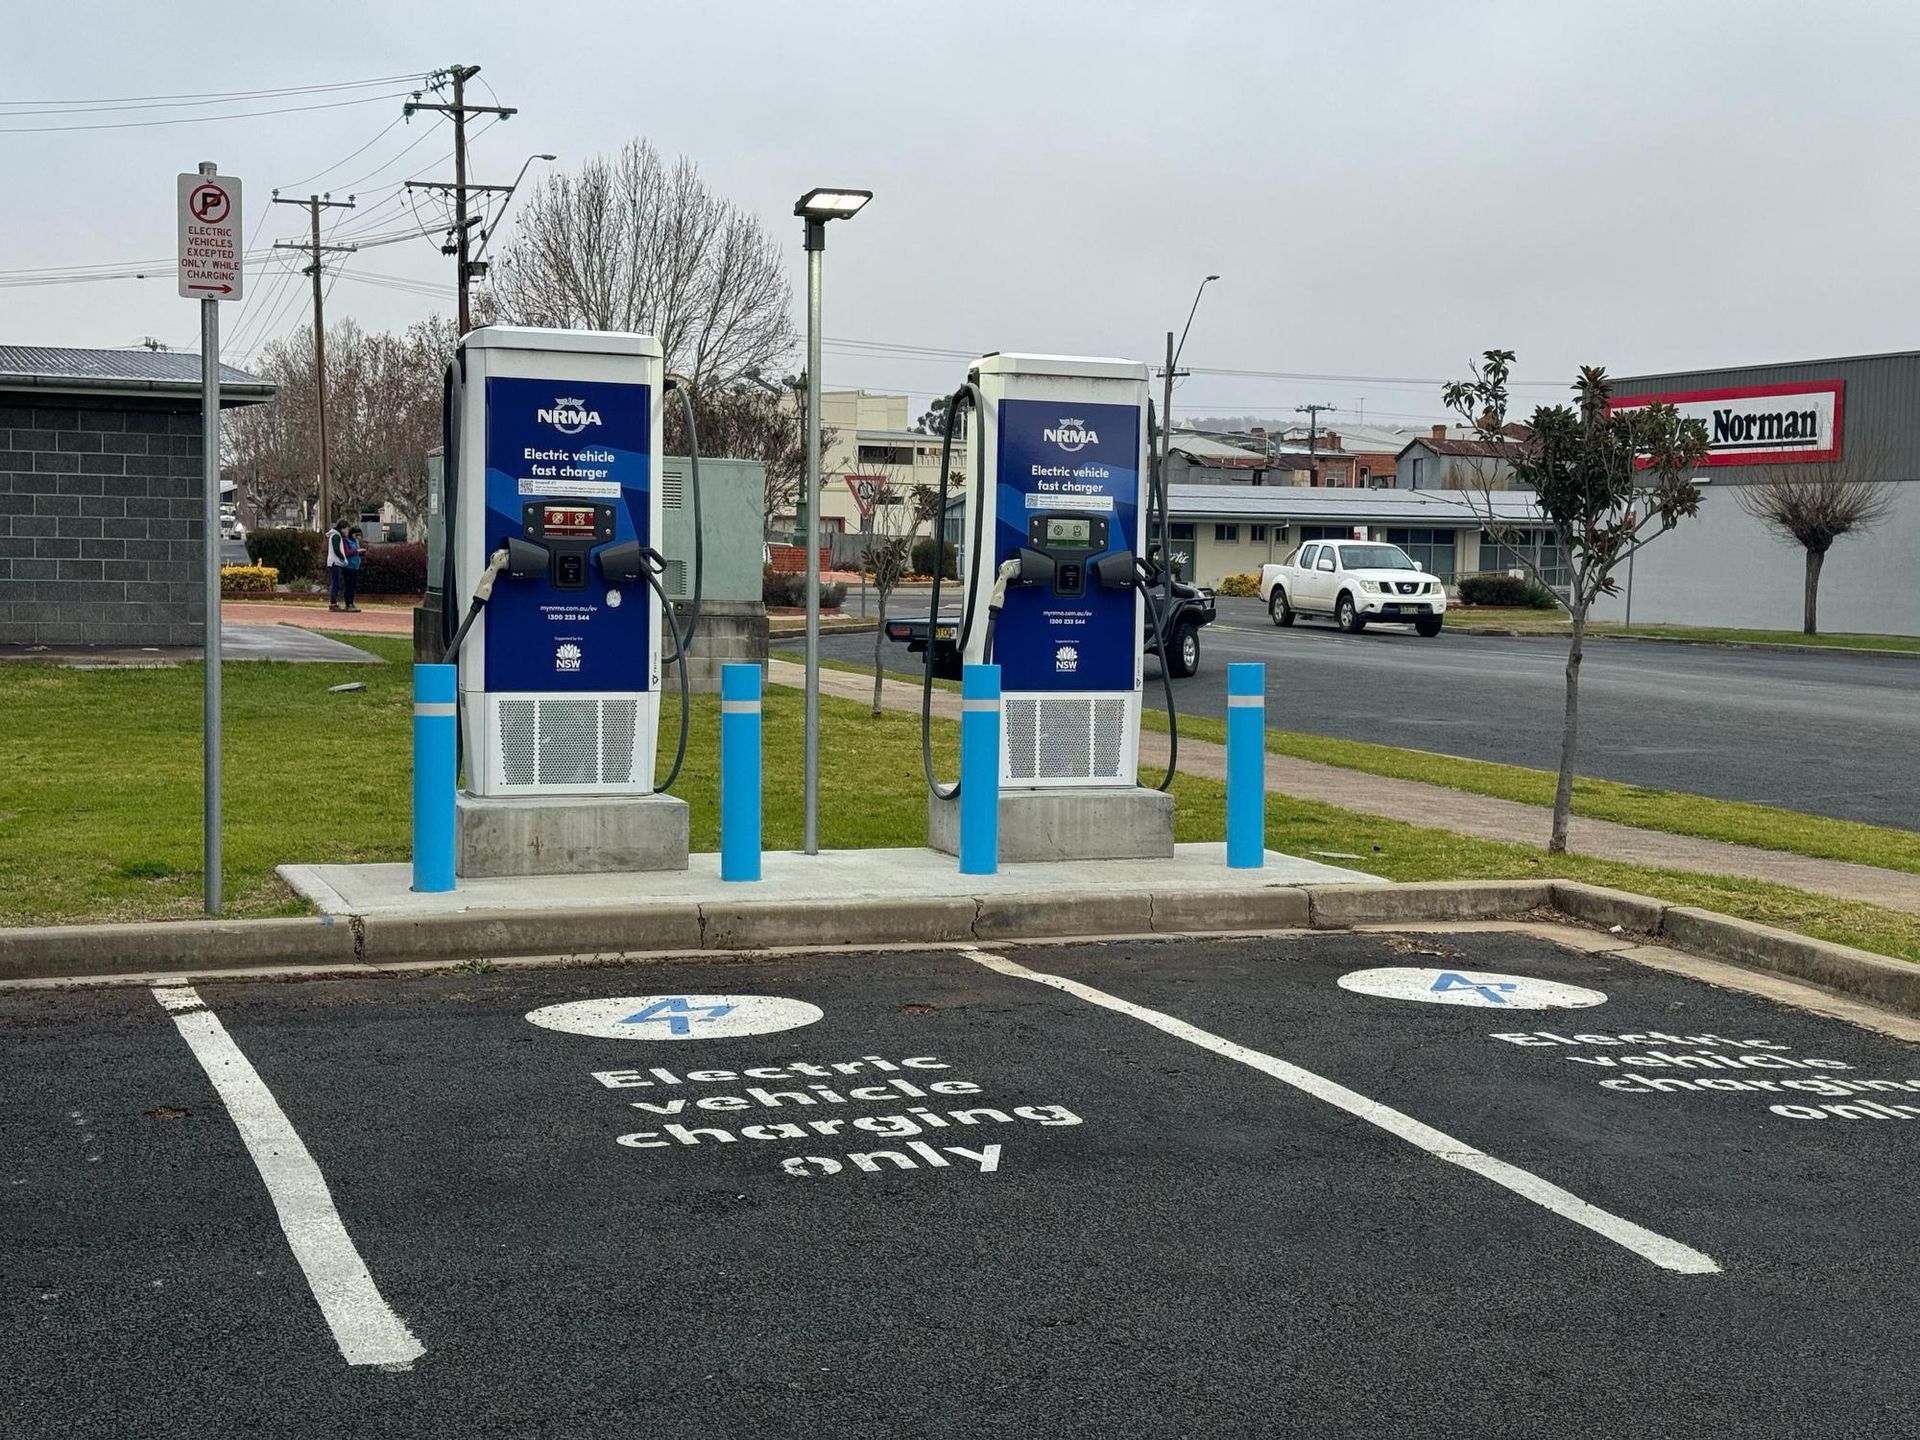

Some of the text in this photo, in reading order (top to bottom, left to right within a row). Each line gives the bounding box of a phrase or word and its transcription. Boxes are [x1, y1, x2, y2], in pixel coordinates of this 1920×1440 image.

[188, 226, 232, 237] ELECTRIC
[188, 237, 233, 248] VEHICLES
[187, 248, 234, 259] EXCEPTED
[181, 258, 240, 271] ONLY WHILE
[187, 269, 235, 281] CHARGING
[537, 409, 602, 426] NRMA
[1713, 409, 1817, 443] Norman
[1043, 428, 1099, 444] NRMA
[524, 448, 615, 463] Electric vehicle
[531, 464, 608, 480] fast charger
[1031, 465, 1109, 479] Electric vehicle
[1037, 479, 1104, 495] fast charger
[556, 659, 581, 668] NSW
[1056, 660, 1078, 669] NSW
[1488, 1031, 1792, 1050] Electric
[1565, 1050, 1856, 1069] vehicle
[590, 1055, 952, 1089] Electric
[1599, 1073, 1920, 1096] chargin
[630, 1079, 983, 1115] vehicle
[615, 1104, 1084, 1149] charging
[779, 1140, 1002, 1178] only
